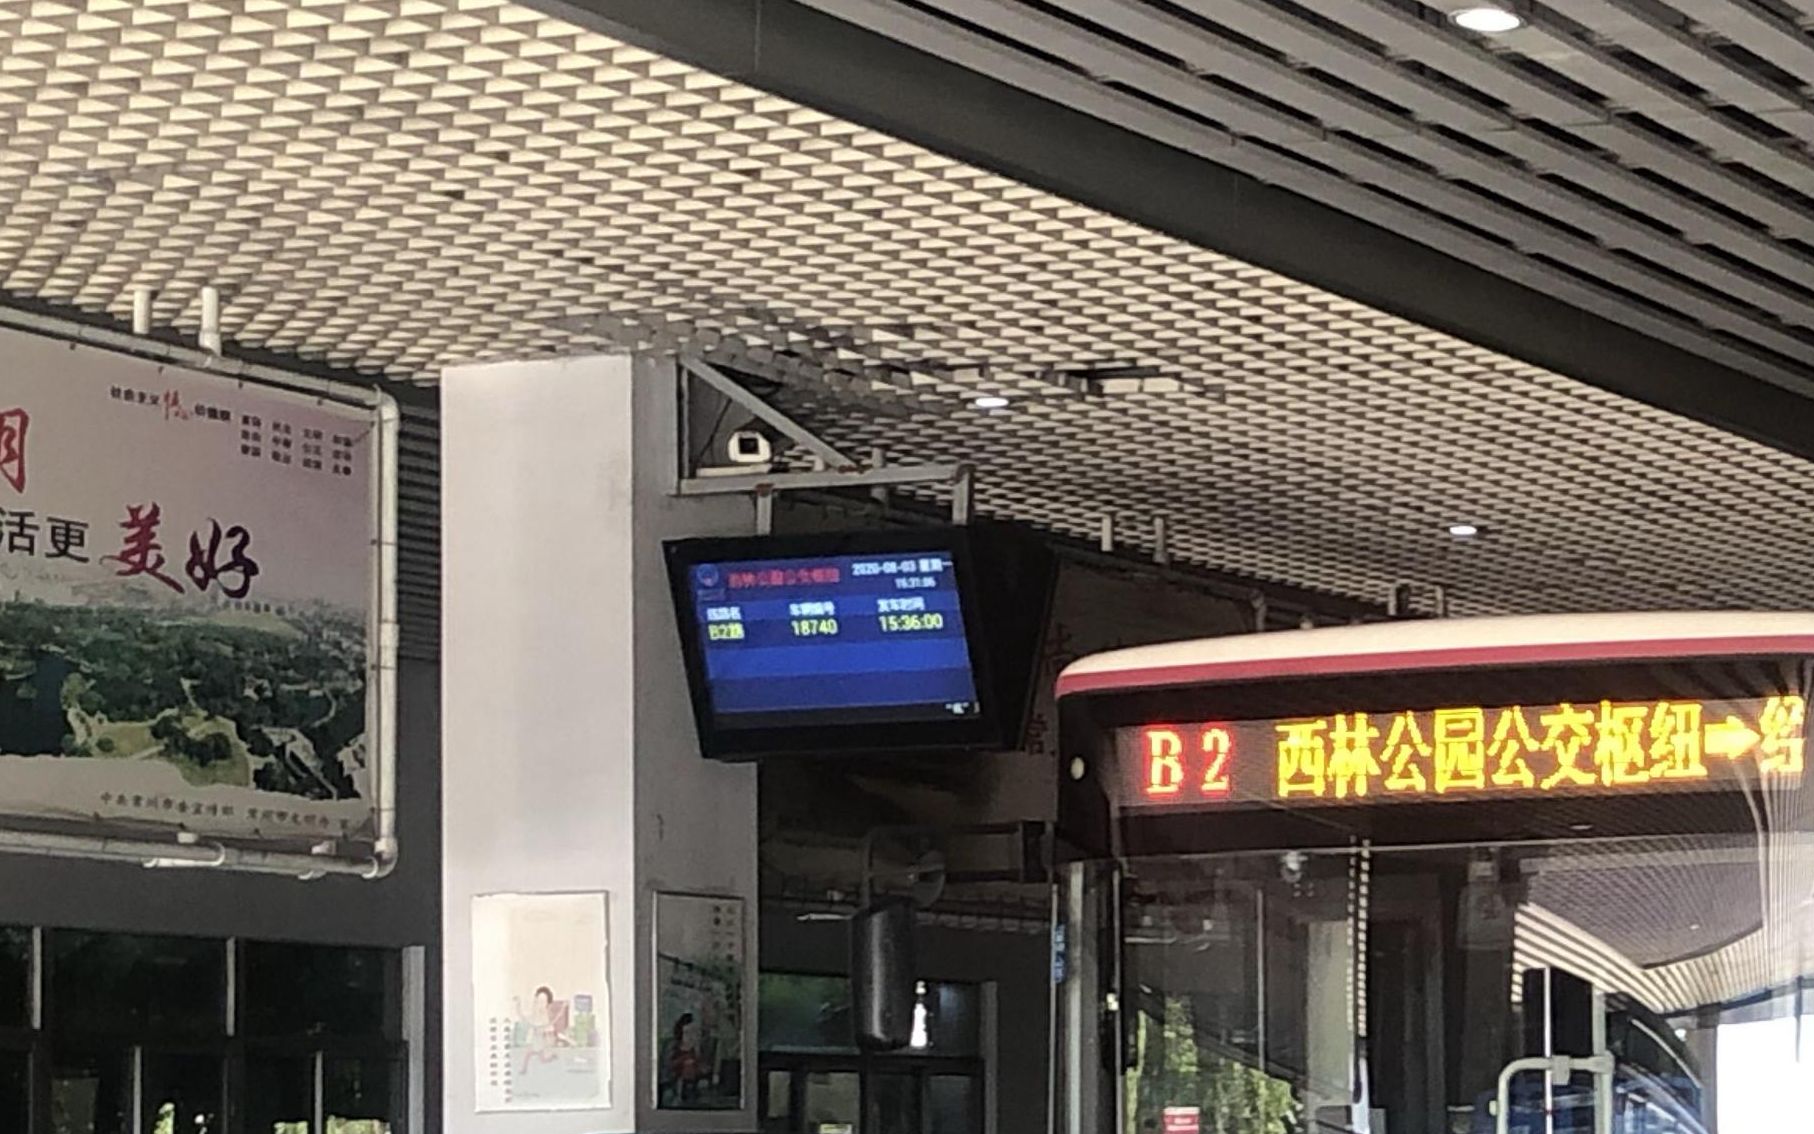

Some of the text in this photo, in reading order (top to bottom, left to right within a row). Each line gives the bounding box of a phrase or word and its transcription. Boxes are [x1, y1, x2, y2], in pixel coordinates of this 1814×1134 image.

[791, 618, 838, 636] 18740
[879, 613, 943, 632] 15:36:00
[1275, 700, 1708, 799] 西林公园公交枢纽
